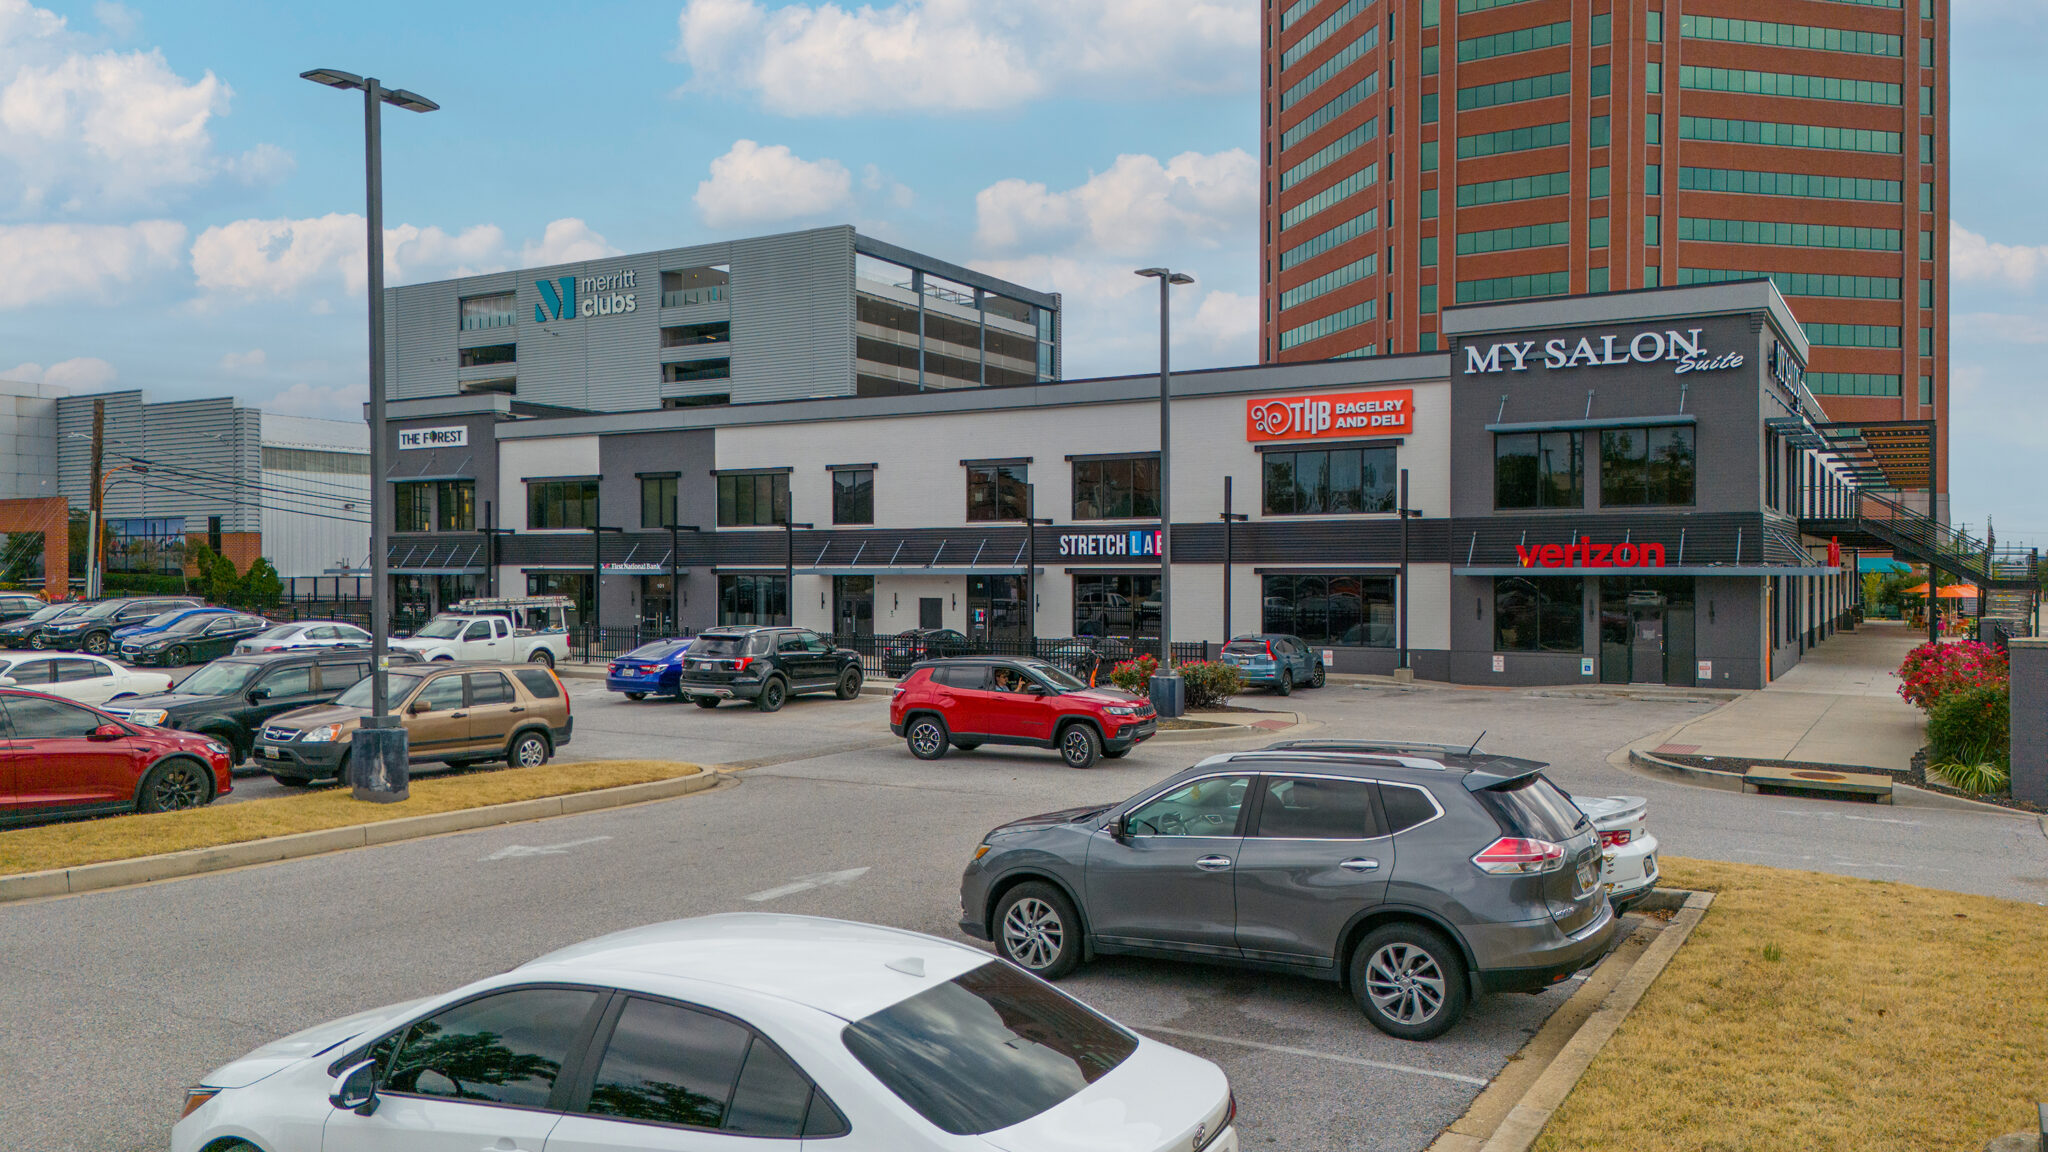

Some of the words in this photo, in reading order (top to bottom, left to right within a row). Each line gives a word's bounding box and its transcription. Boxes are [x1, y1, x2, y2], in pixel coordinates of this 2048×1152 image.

[581, 269, 636, 292] merritt
[581, 292, 637, 317] clubs
[1464, 340, 1535, 374] MY
[1545, 329, 1703, 369] SALON
[1675, 349, 1744, 374] Suite
[1290, 398, 1331, 435] THB
[1335, 399, 1404, 415] BAGELRY
[1335, 415, 1368, 429] AND
[1371, 413, 1405, 427] DELI
[400, 433, 421, 446] THE
[1060, 534, 1126, 556] STRETCH
[1515, 536, 1666, 568] verizon
[611, 562, 624, 570] First
[624, 562, 646, 570] National
[646, 562, 661, 570] Bank
